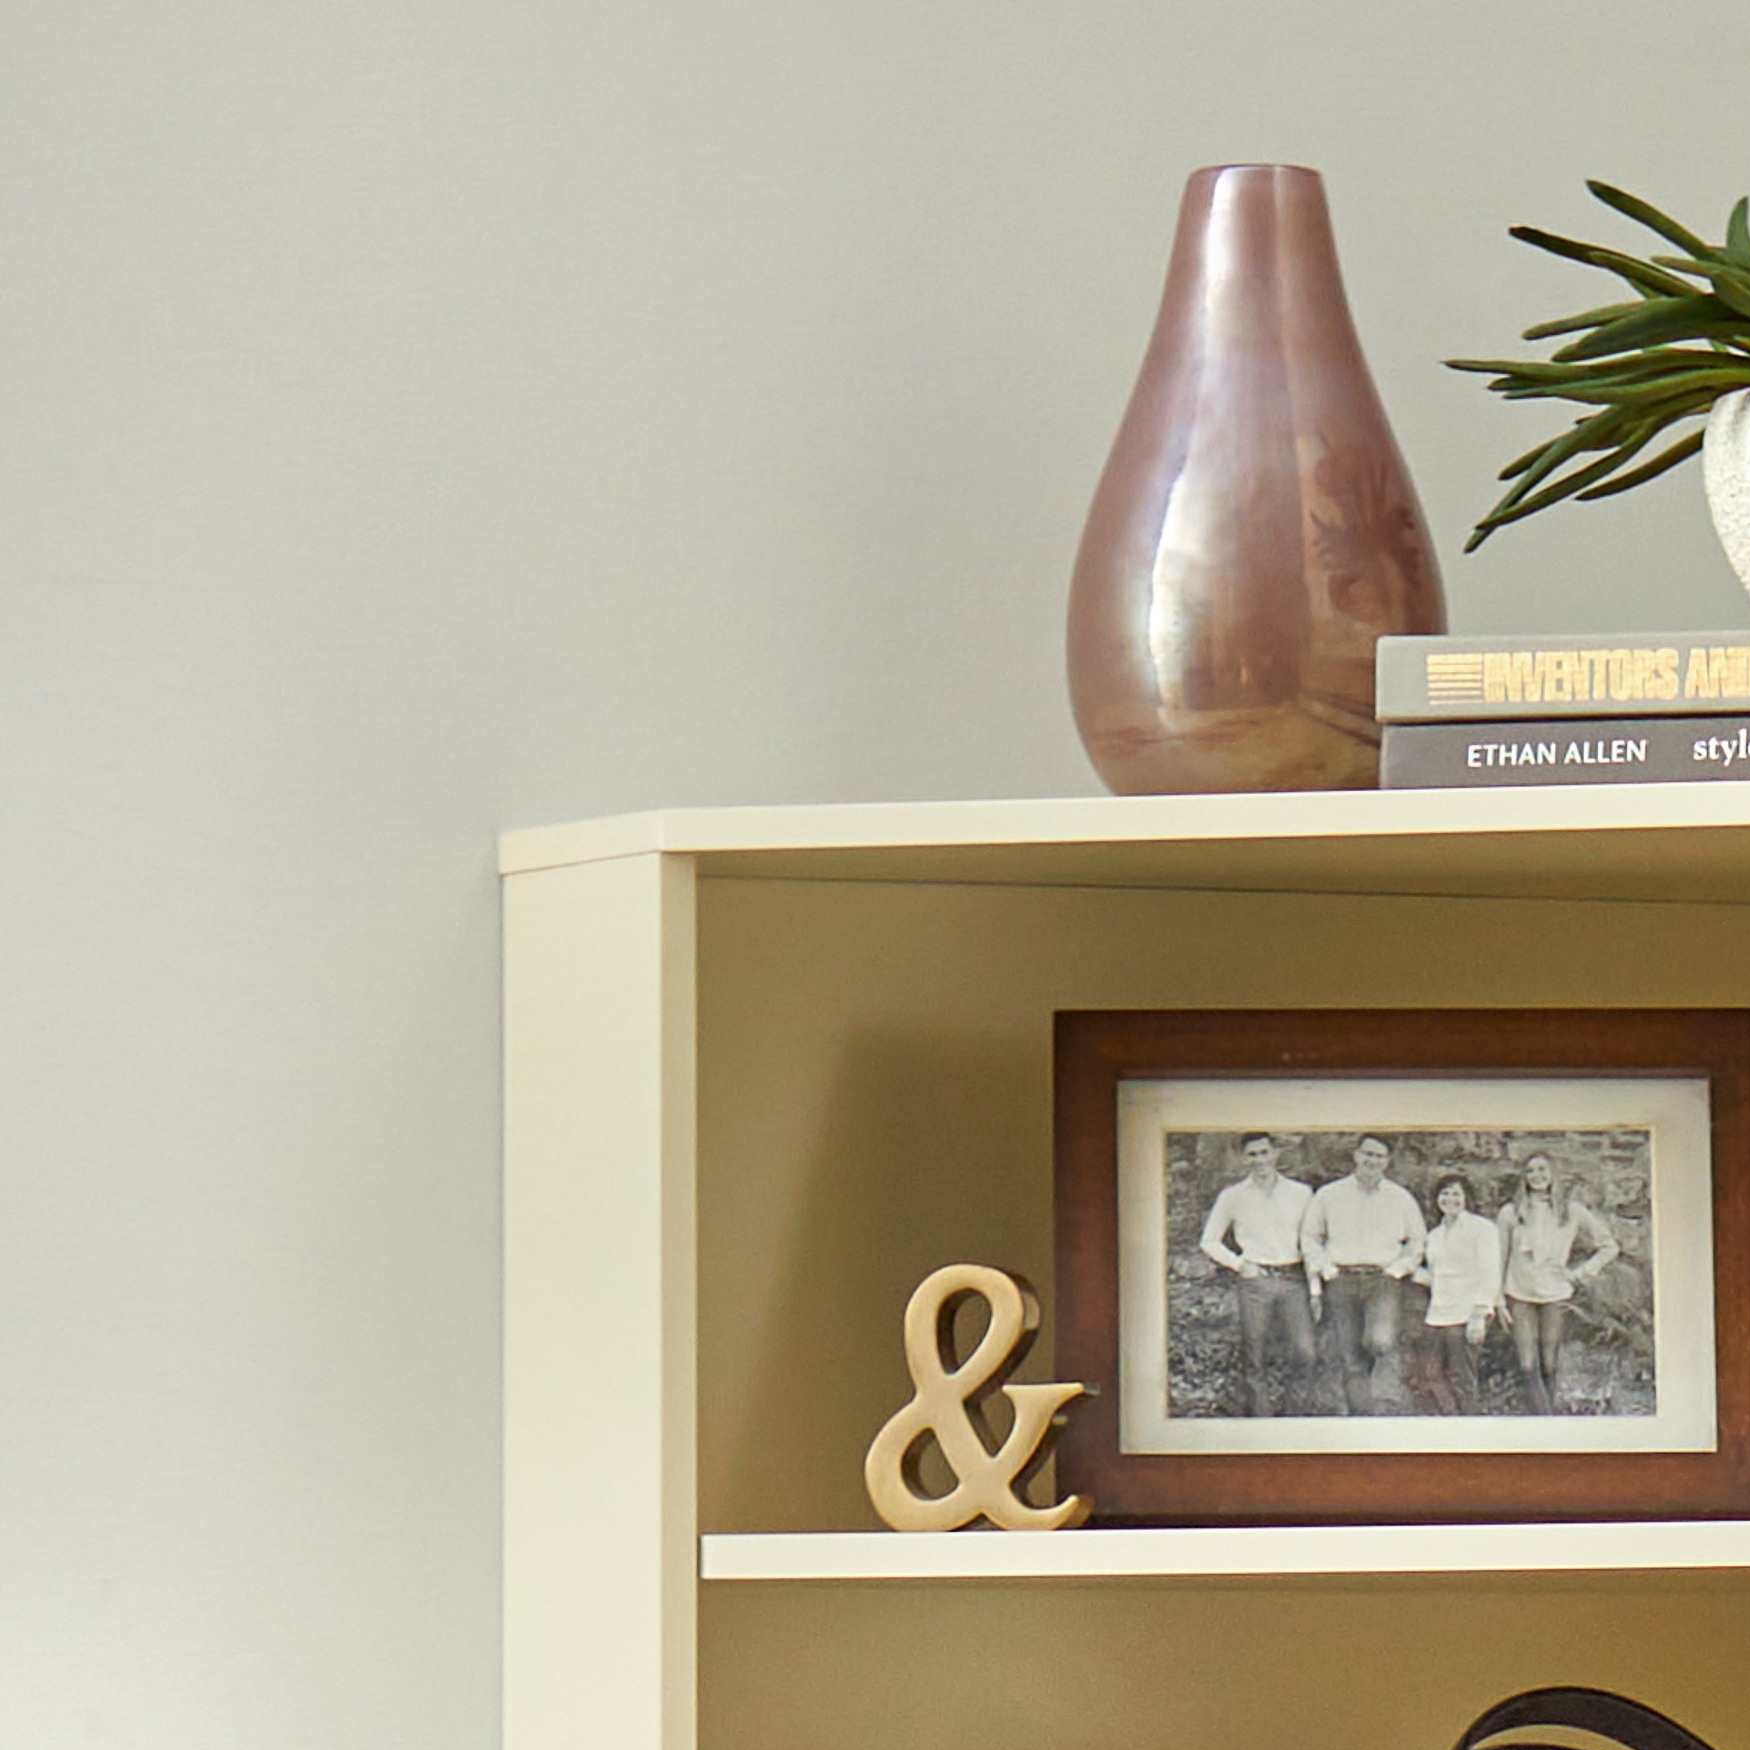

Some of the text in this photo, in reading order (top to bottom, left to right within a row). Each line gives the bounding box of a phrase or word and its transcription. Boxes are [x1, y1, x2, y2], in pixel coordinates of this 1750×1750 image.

[1483, 647, 1680, 702] INVENTORS
[1466, 739, 1648, 768] ETHAN ALLEN
